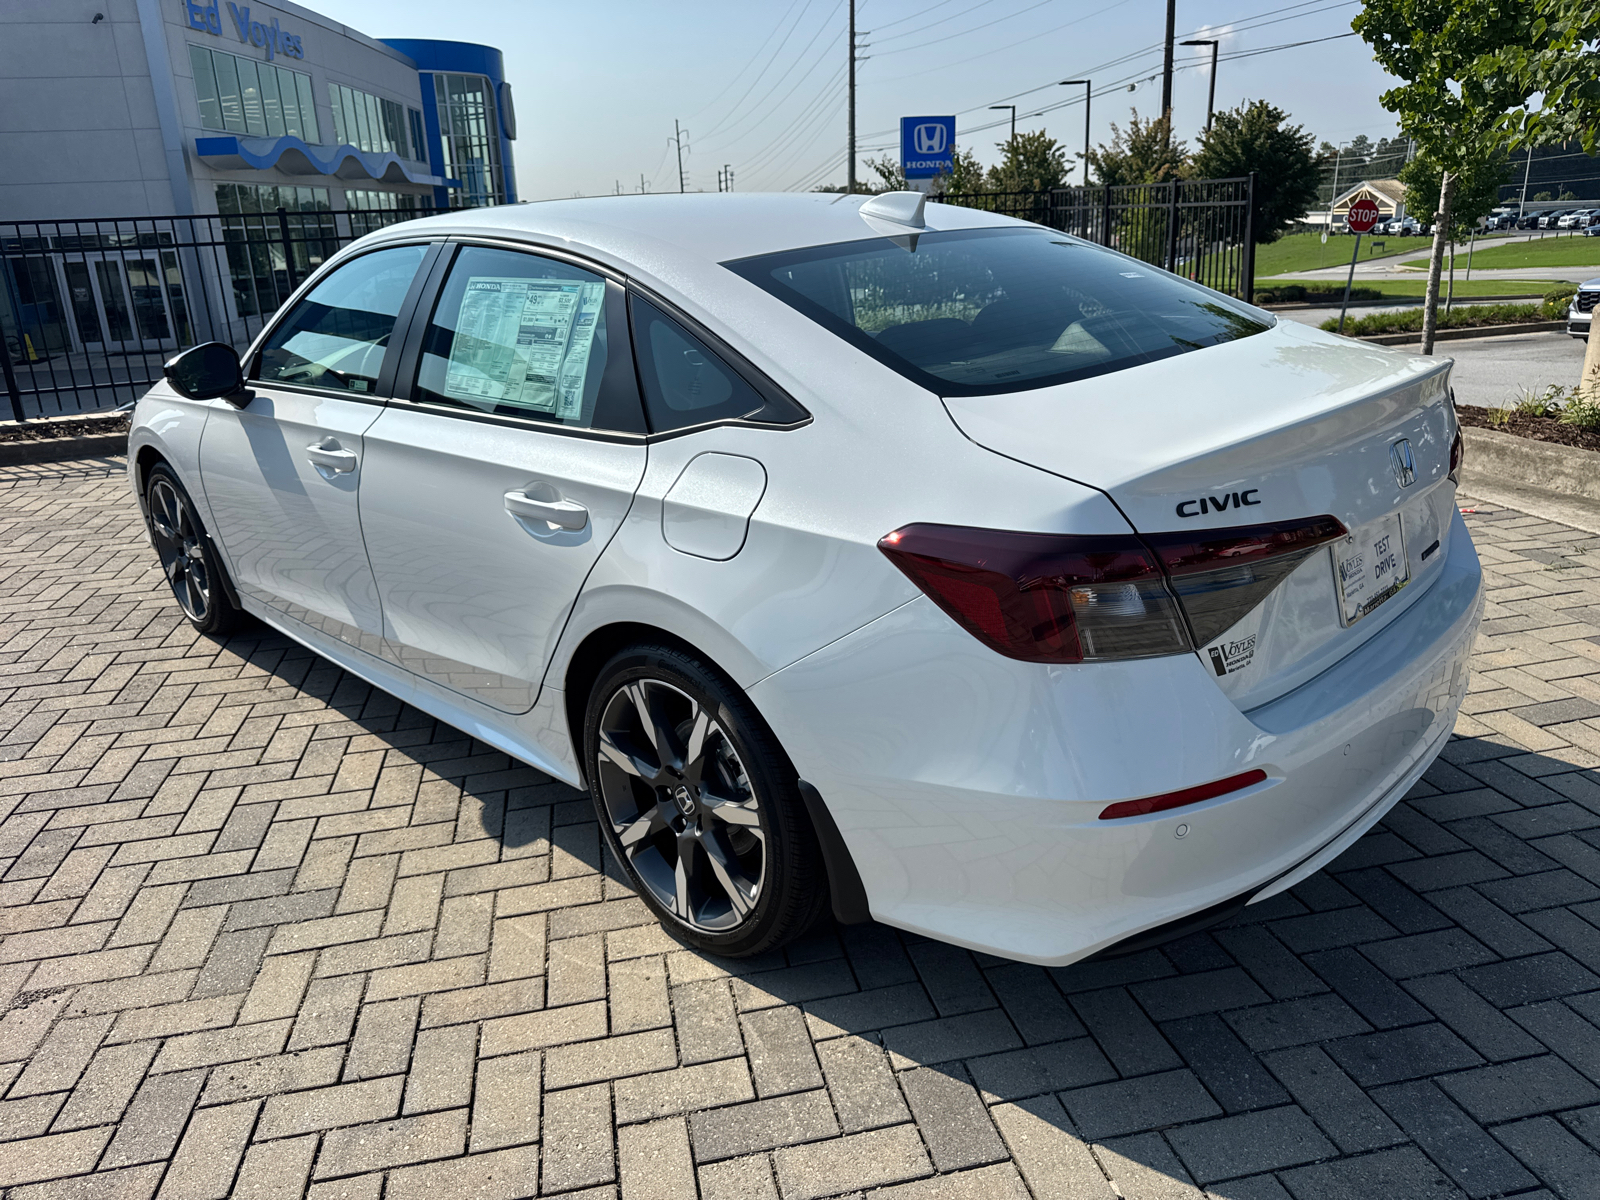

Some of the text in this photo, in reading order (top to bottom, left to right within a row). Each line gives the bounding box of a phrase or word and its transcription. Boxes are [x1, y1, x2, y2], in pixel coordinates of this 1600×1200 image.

[186, 0, 304, 61] Ed Voyles
[906, 160, 953, 169] HONDA
[1349, 208, 1378, 222] STOP
[475, 282, 501, 291] HONDA
[529, 294, 538, 305] 49
[1176, 488, 1261, 518] CIVIC
[1373, 534, 1390, 558] TEST
[1374, 553, 1397, 580] DRIVE
[1210, 650, 1219, 658] ED
[1220, 636, 1256, 662] VOYLES
[1225, 654, 1249, 667] HONDA
